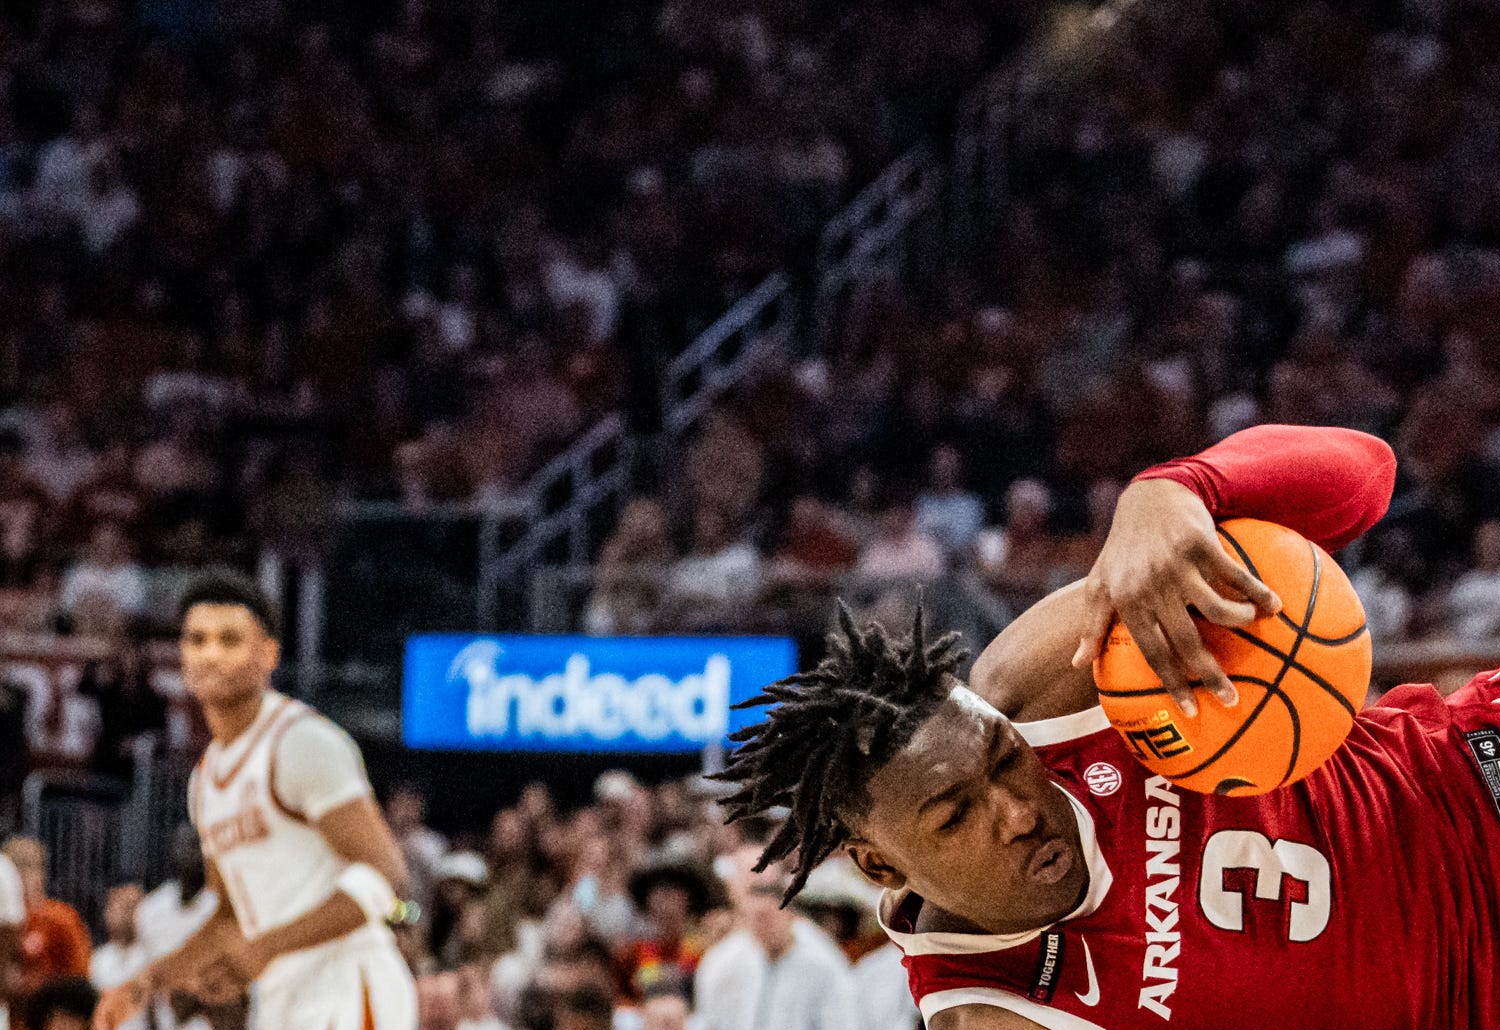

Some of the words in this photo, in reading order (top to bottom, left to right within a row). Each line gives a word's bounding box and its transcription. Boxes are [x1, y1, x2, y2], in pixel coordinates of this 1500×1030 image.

[450, 640, 731, 740] indeed
[1085, 763, 1121, 796] SEC
[1480, 741, 1496, 757] 46
[1138, 775, 1181, 1021] ARKANSA
[1200, 830, 1331, 942] 3
[1039, 934, 1059, 986] TOGETHER
